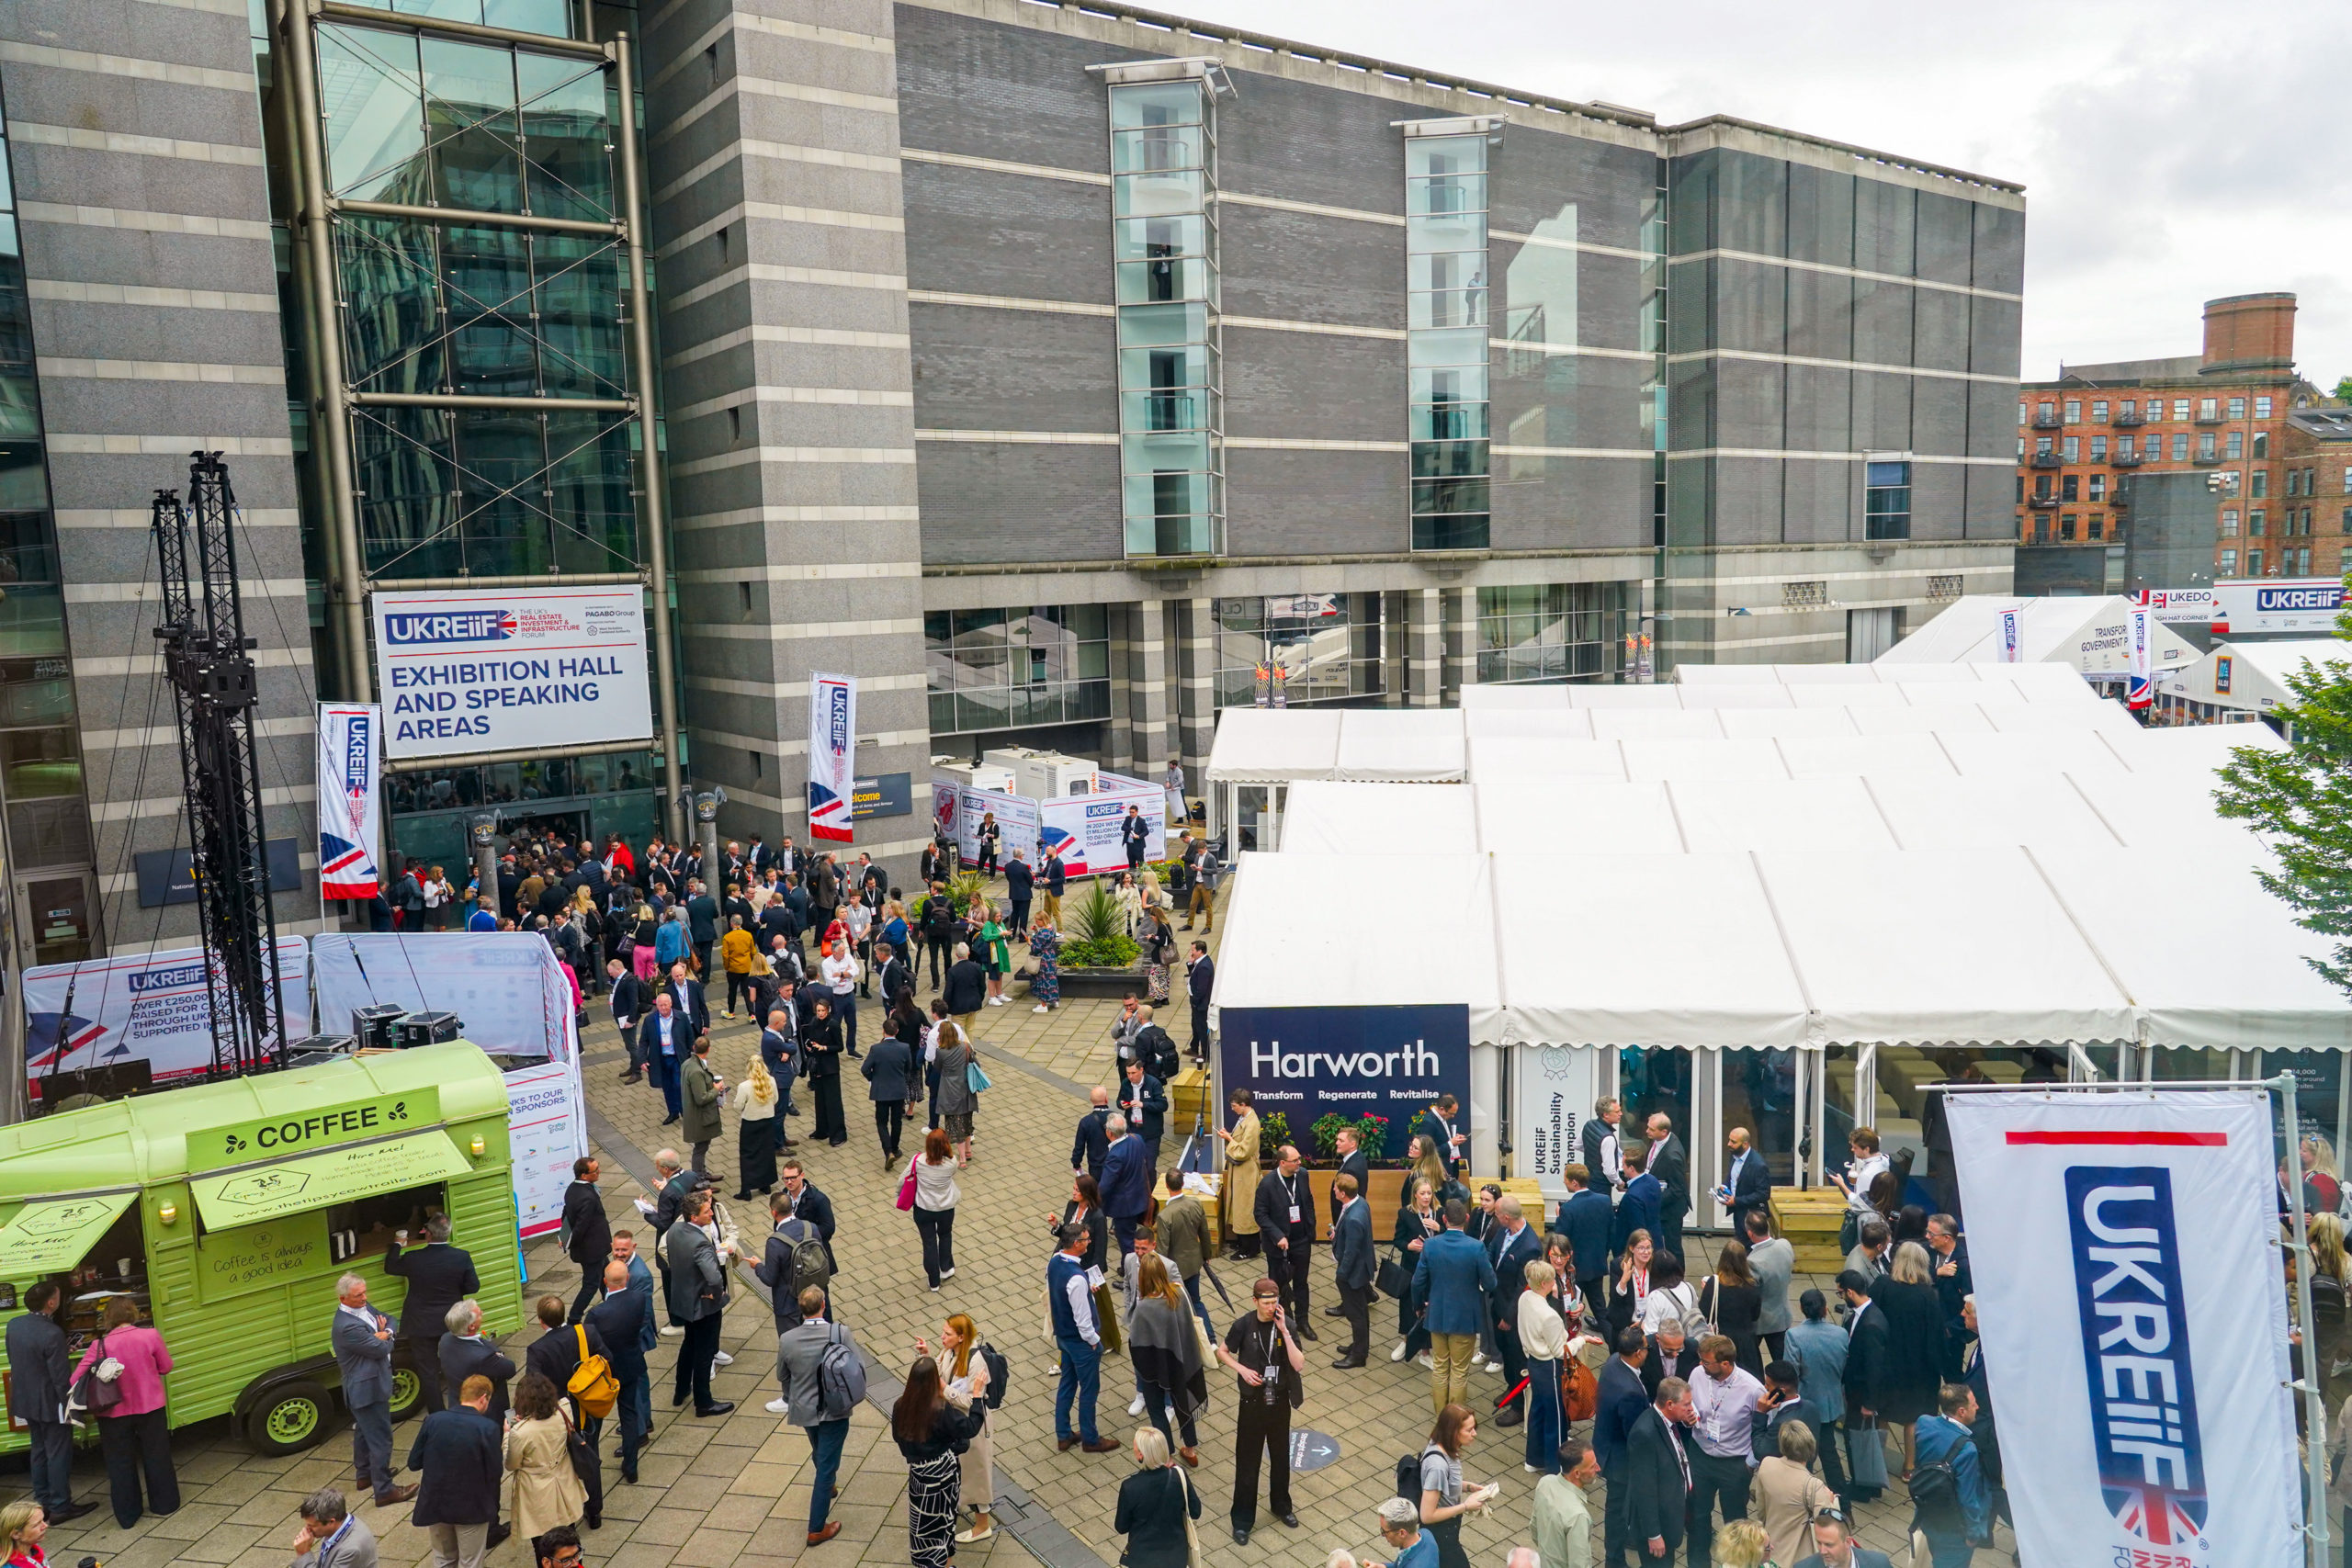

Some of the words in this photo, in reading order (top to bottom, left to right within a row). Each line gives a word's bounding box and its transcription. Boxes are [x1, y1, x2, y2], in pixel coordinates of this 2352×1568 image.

[2169, 592, 2211, 602] UKEDO
[2261, 591, 2340, 608] UKREiiF
[391, 615, 498, 640] UKREiiF
[2095, 625, 2127, 637] TRANSFOR
[2081, 638, 2123, 652] GOVERNMENT
[391, 660, 549, 687] EXHIBITION
[559, 656, 623, 677] HALL
[393, 692, 457, 714] AND
[465, 682, 599, 709] SPEAKING
[396, 716, 491, 740] AREAS
[833, 691, 846, 747] UKREiiF
[349, 720, 366, 785] UKREiiF
[1088, 805, 1120, 816] UKREiiF
[132, 967, 206, 989] UKREiiF
[132, 1000, 162, 1010] OVER
[132, 1009, 173, 1021] RAISED
[176, 1005, 198, 1013] FOR
[132, 1015, 188, 1030] THROUGH
[133, 1023, 200, 1039] SUPPORTED
[1250, 1040, 1440, 1077] Harworth
[515, 1096, 567, 1114] SPONSORS:
[528, 1094, 540, 1102] TO
[543, 1089, 563, 1099] OUR
[1253, 1091, 1304, 1100] Transform
[1318, 1090, 1377, 1100] Regenerate
[1390, 1089, 1440, 1099] Revitalise
[257, 1106, 379, 1148] COFFEE
[1550, 1092, 1563, 1174] Sustainability
[1535, 1127, 1546, 1174] UKREiiF
[1565, 1112, 1576, 1168] hampion
[232, 1168, 447, 1218] www.thetipsycowtrailer.com
[213, 1255, 256, 1273] Coffee
[275, 1242, 313, 1258] always
[229, 1273, 238, 1283] a
[243, 1263, 273, 1283] good
[277, 1258, 302, 1271] idea
[2083, 1185, 2189, 1491] UKREiiF
[1297, 1432, 1308, 1451] Straight
[1295, 1451, 1305, 1468] ahead
